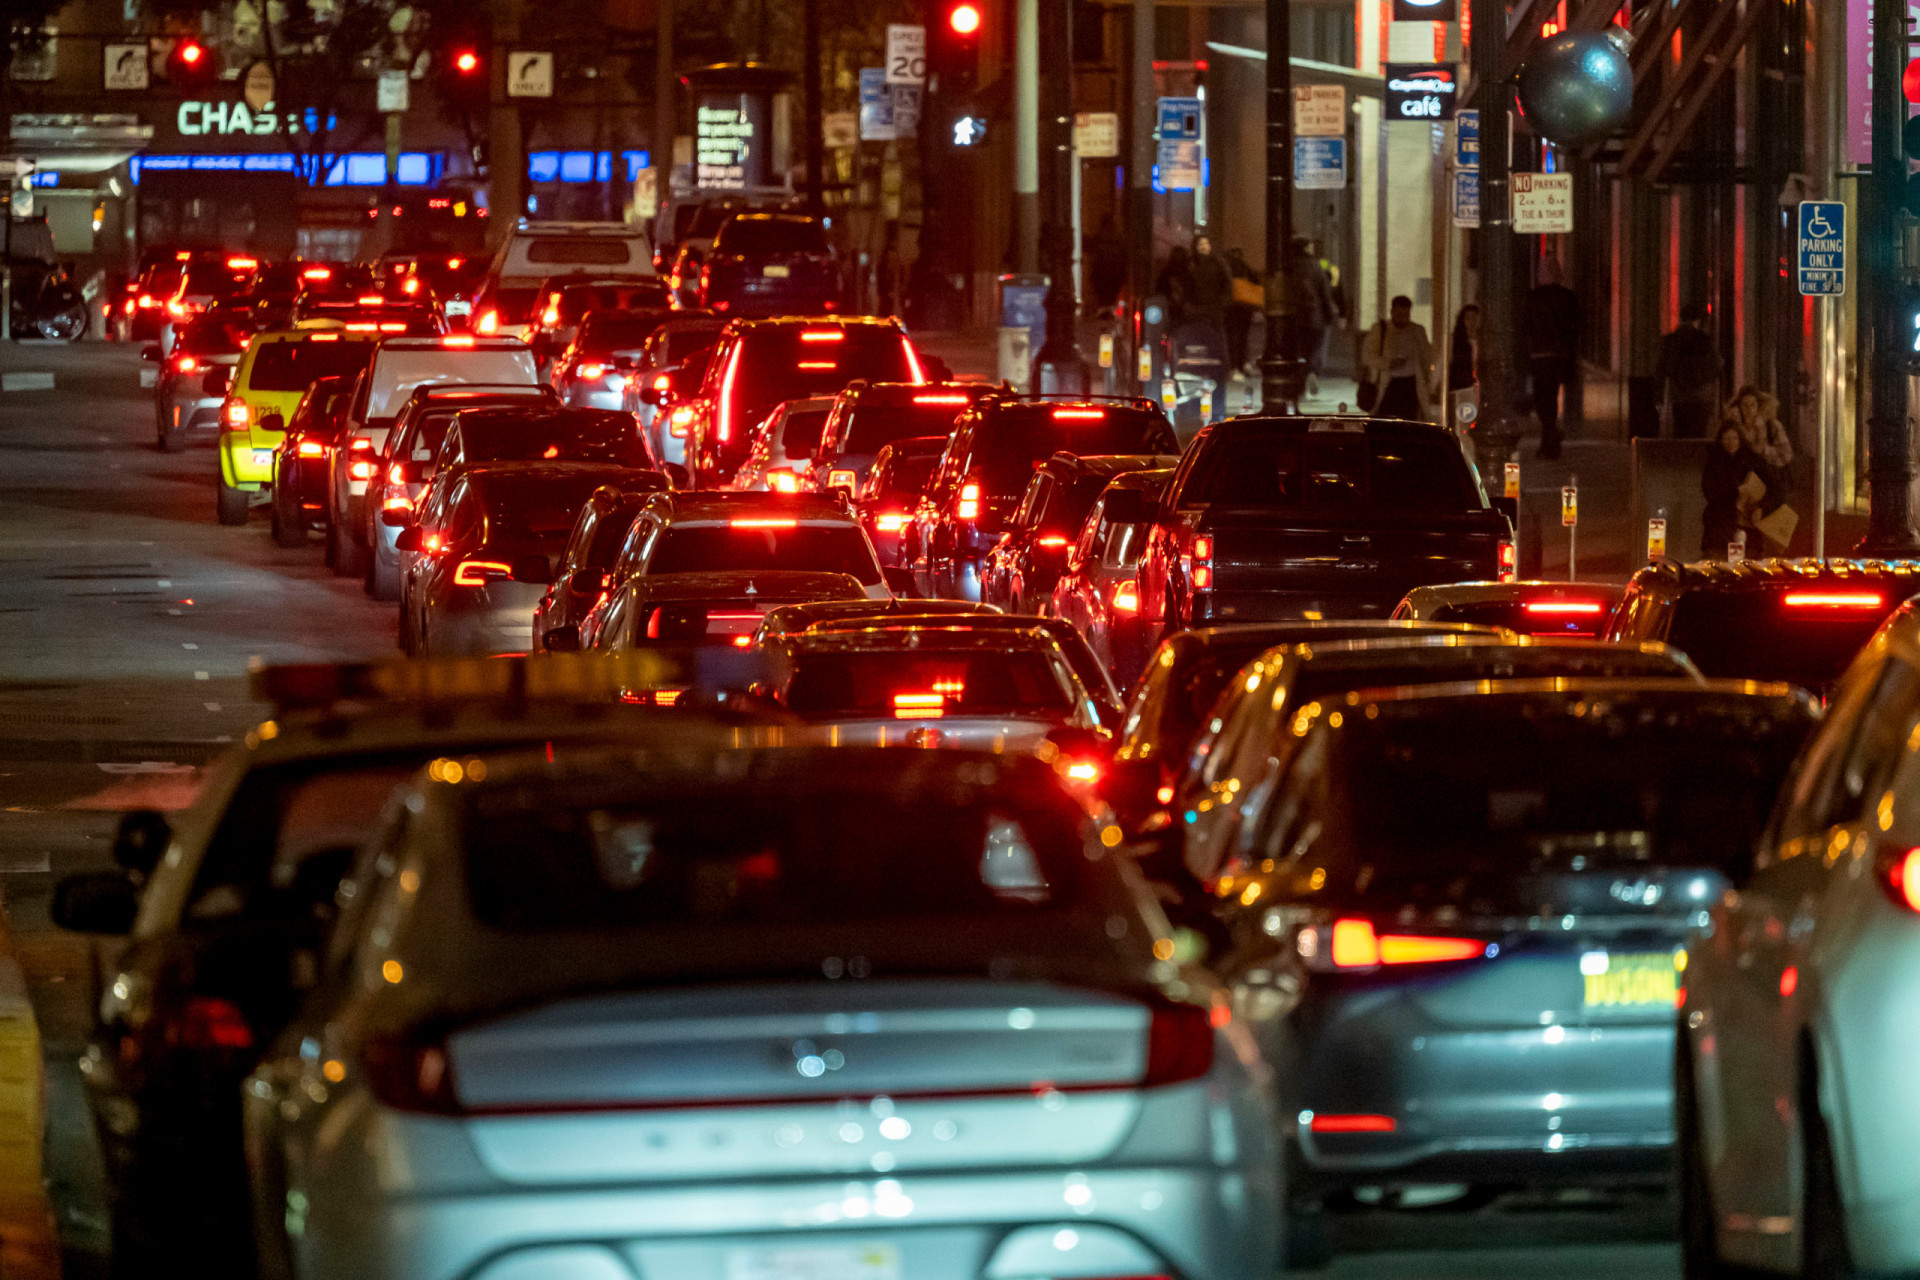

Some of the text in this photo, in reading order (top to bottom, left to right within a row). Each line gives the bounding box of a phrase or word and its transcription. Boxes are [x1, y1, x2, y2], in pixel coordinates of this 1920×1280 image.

[1400, 95, 1442, 117] café
[177, 100, 299, 135] CHAS
[1515, 176, 1568, 192] NO PARKING
[1521, 209, 1534, 219] TUE
[1545, 209, 1565, 219] THUR
[1801, 238, 1842, 253] PARKING
[1809, 253, 1835, 267] ONLY
[1801, 282, 1817, 292] FINE
